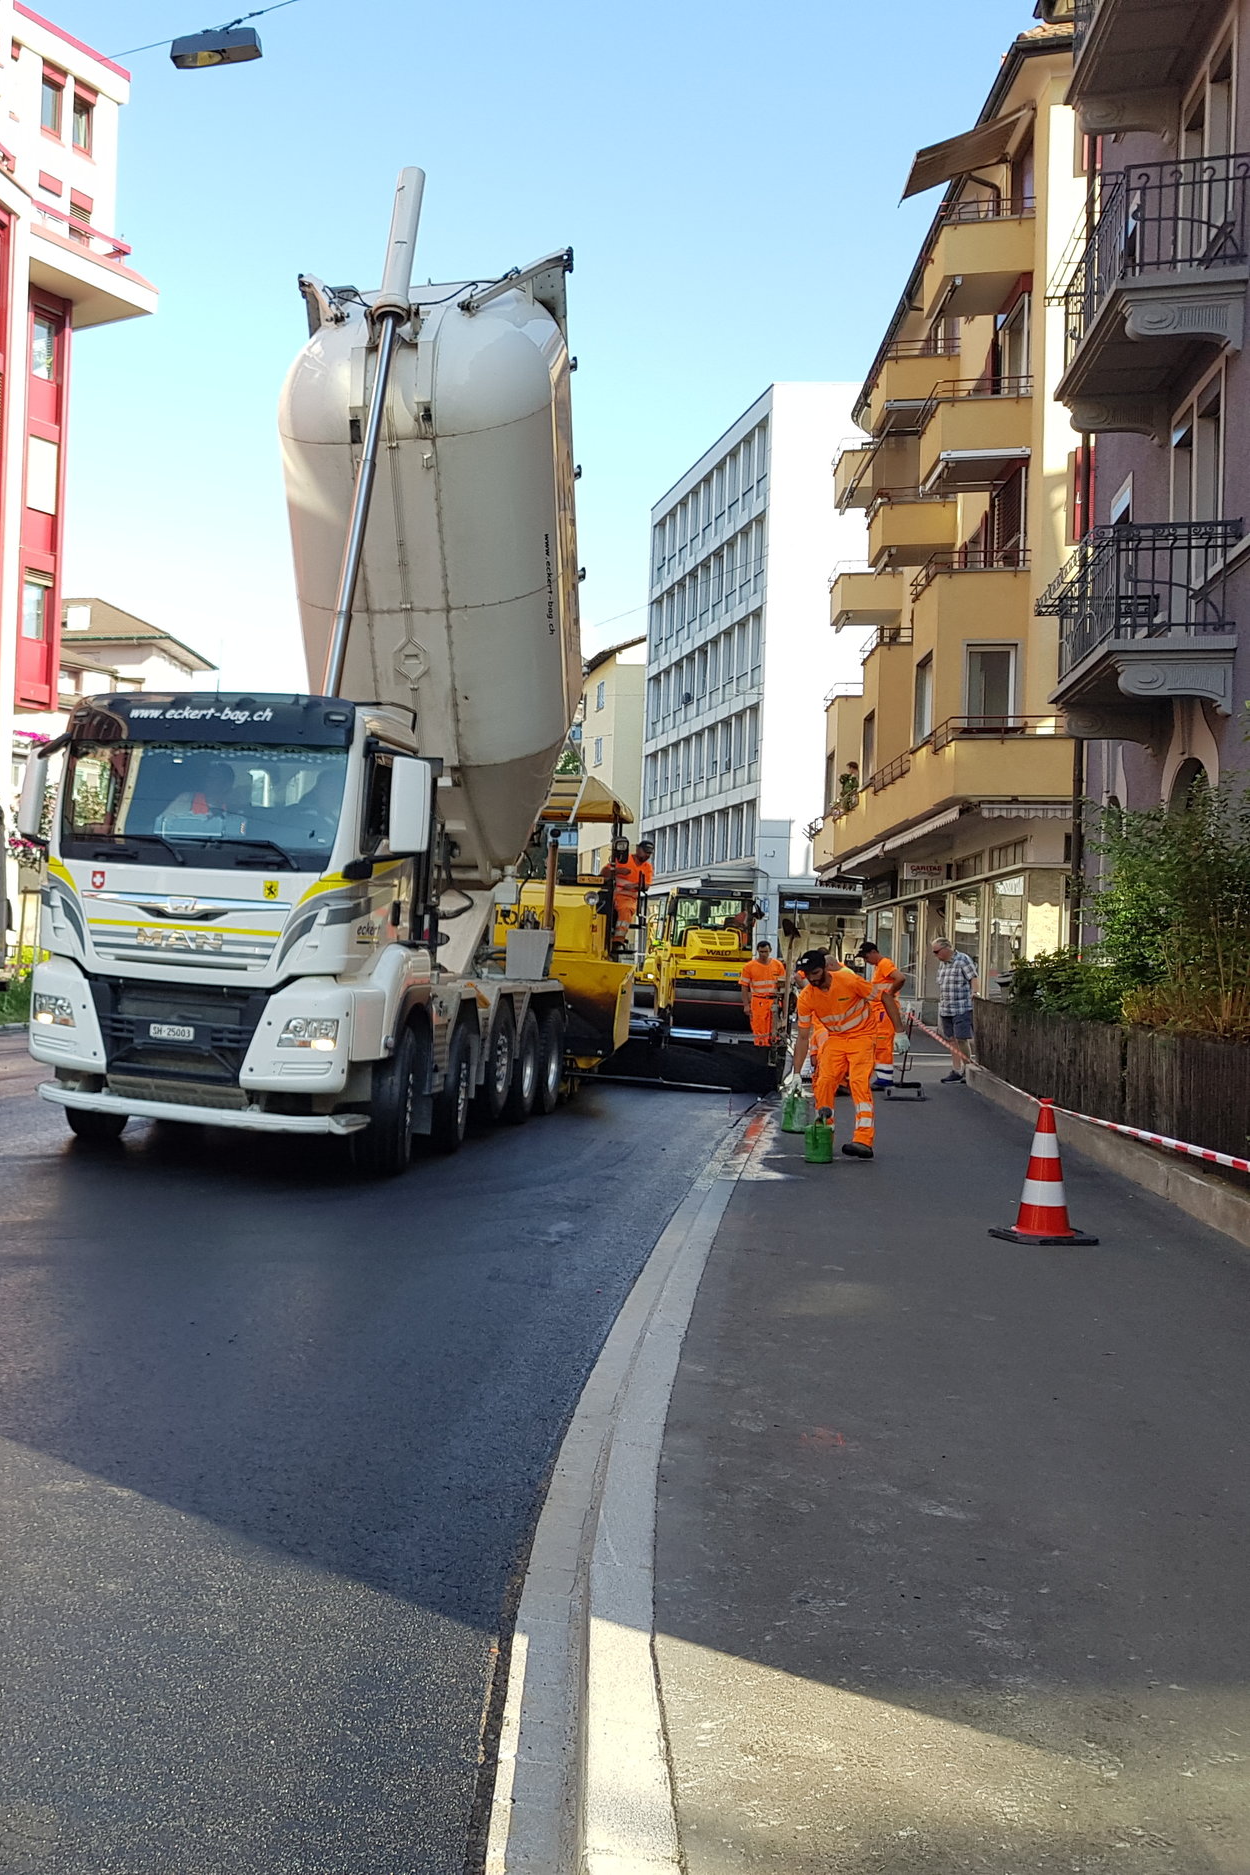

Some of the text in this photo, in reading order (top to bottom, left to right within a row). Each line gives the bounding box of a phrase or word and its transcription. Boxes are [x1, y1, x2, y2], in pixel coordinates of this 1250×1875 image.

[544, 533, 556, 636] www.eckert-bag.ch
[130, 706, 273, 724] www.eckert-bag.ch
[136, 927, 223, 951] MAN
